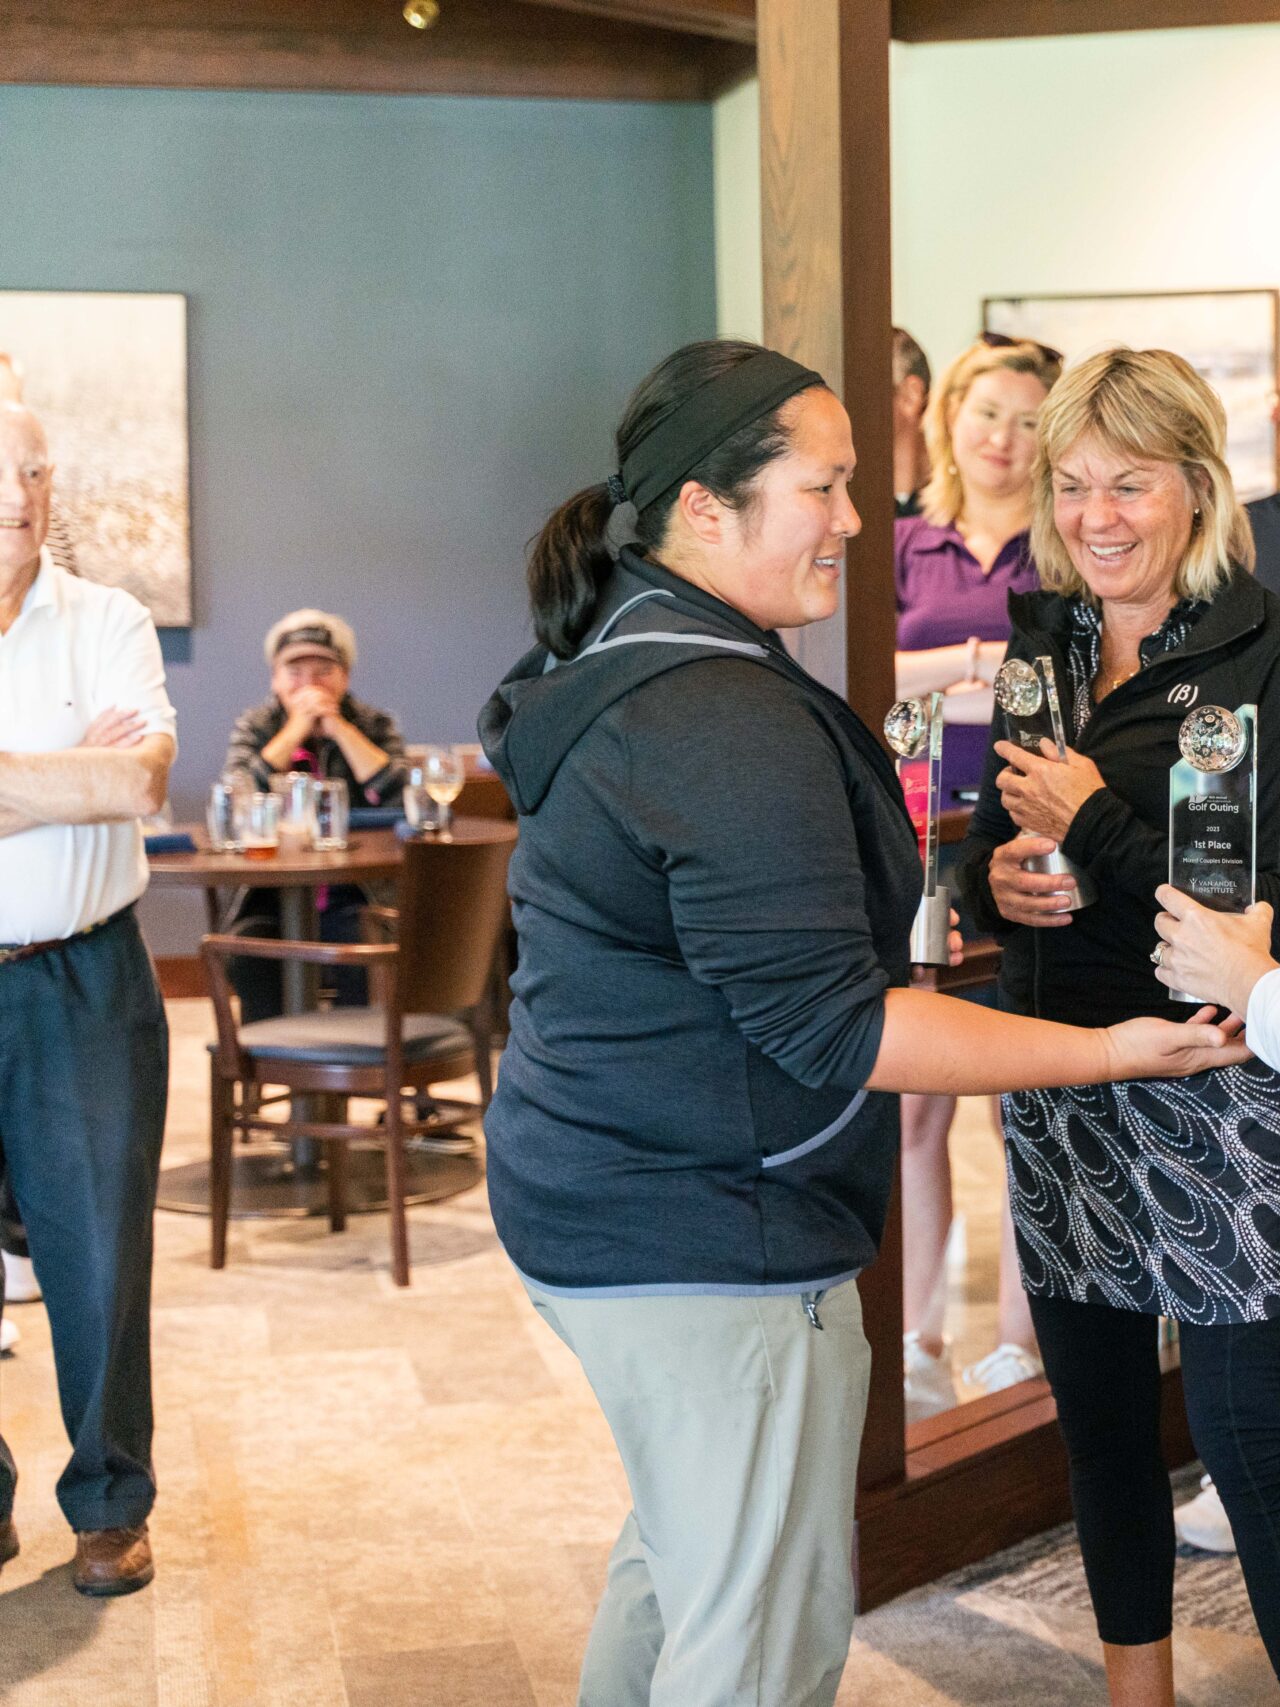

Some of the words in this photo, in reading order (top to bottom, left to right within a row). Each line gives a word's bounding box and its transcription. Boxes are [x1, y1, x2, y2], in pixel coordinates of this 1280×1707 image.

[1188, 803, 1208, 811] Golf
[1209, 803, 1239, 814] Outing
[1194, 840, 1206, 849] 1st
[1207, 840, 1232, 850] Place
[1214, 880, 1238, 889] ANDEL
